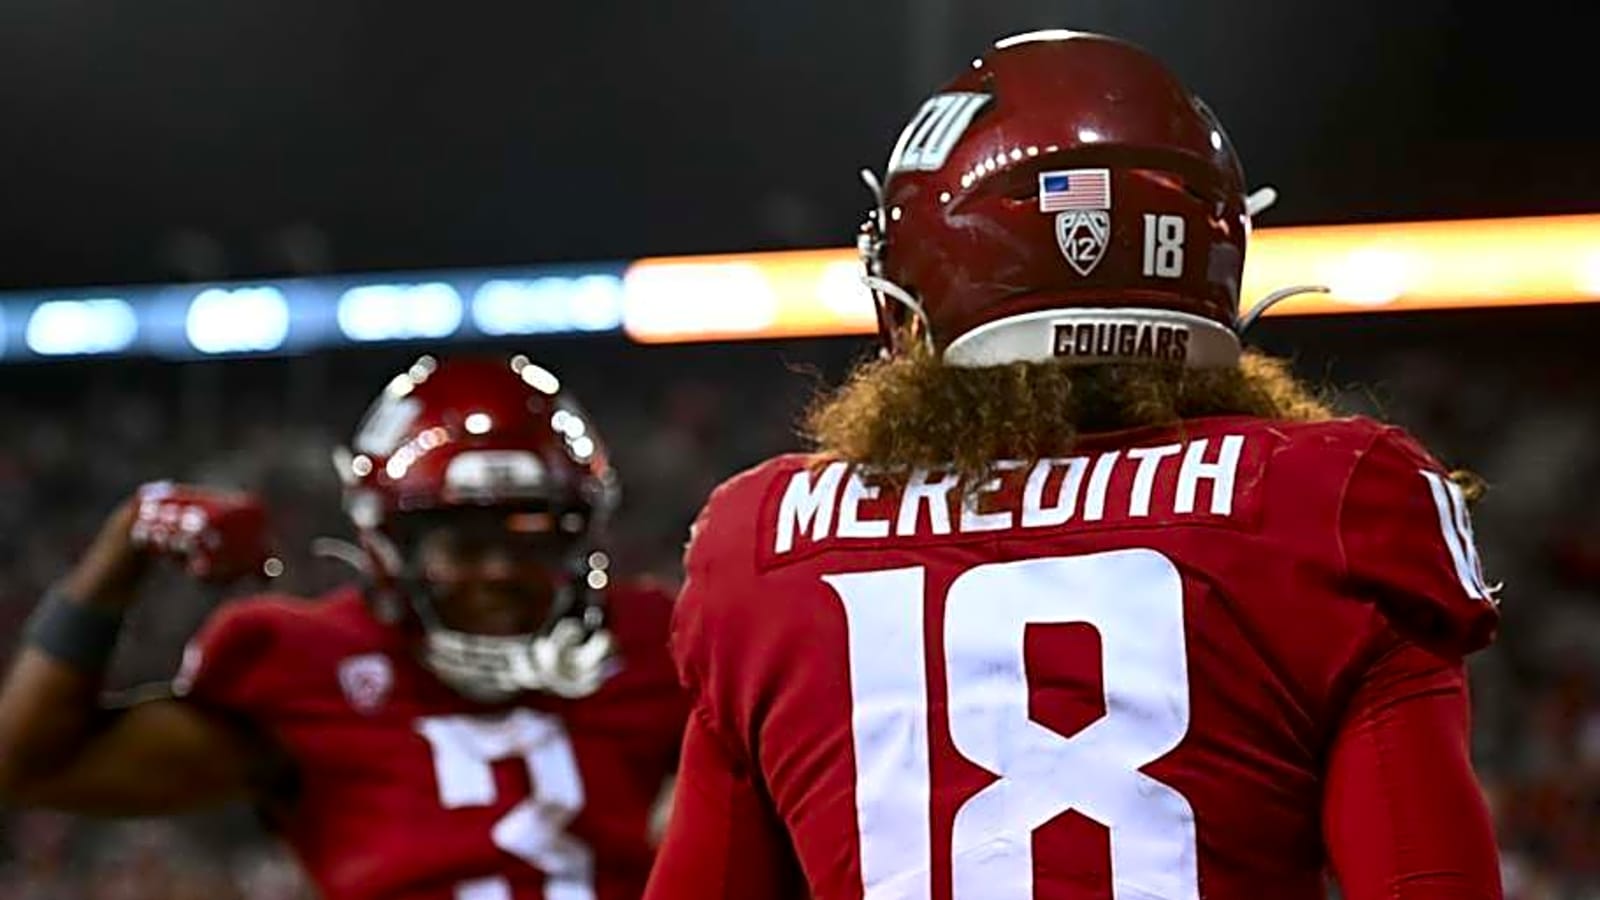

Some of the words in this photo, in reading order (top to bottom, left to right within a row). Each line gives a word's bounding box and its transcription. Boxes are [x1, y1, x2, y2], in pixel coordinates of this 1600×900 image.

[1060, 211, 1108, 248] PAC
[1069, 236, 1097, 261] 12
[1143, 213, 1185, 278] 18
[1053, 323, 1189, 361] COUGARS
[774, 435, 1245, 554] MEREDITH
[821, 548, 1200, 900] 18
[416, 708, 598, 900] 3
